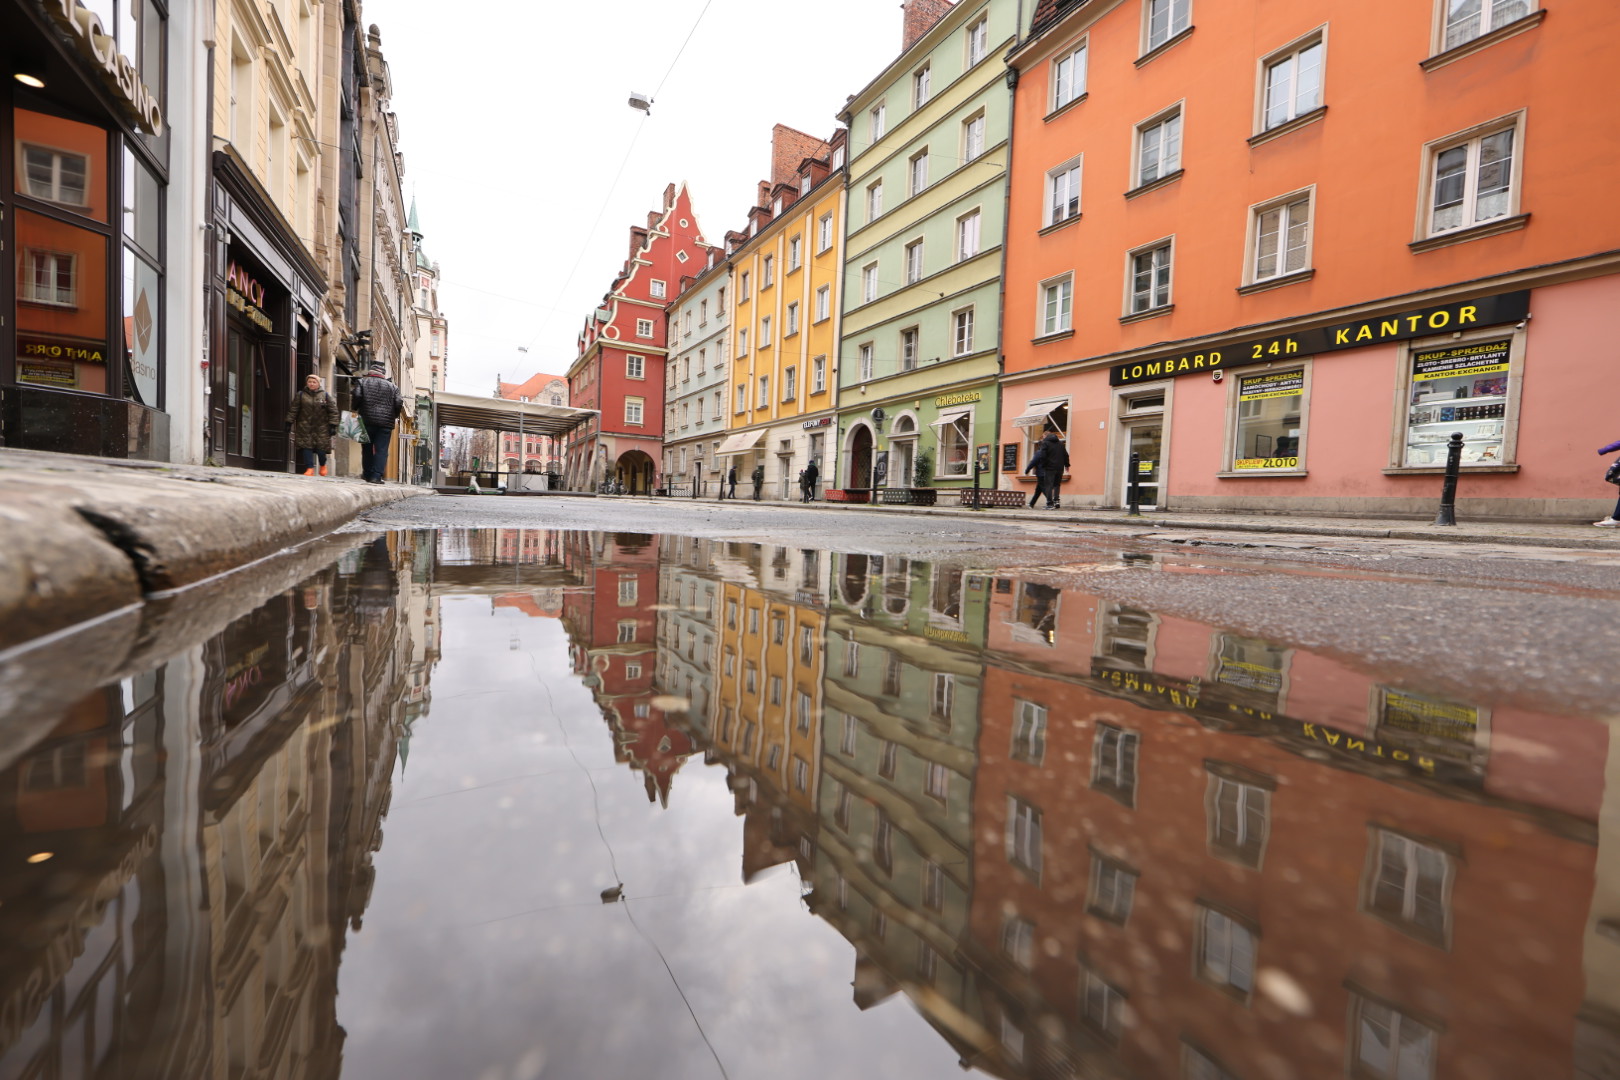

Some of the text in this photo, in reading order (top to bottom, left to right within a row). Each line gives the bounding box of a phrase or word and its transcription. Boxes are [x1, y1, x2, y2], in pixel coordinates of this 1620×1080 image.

[88, 11, 162, 137] CASINO
[1121, 305, 1477, 380] LOMBARD 24h KANTOR
[1455, 358, 1500, 369] SZLACHETNE
[935, 392, 980, 407] Chleboteka
[1263, 457, 1298, 468] ZŁOTO
